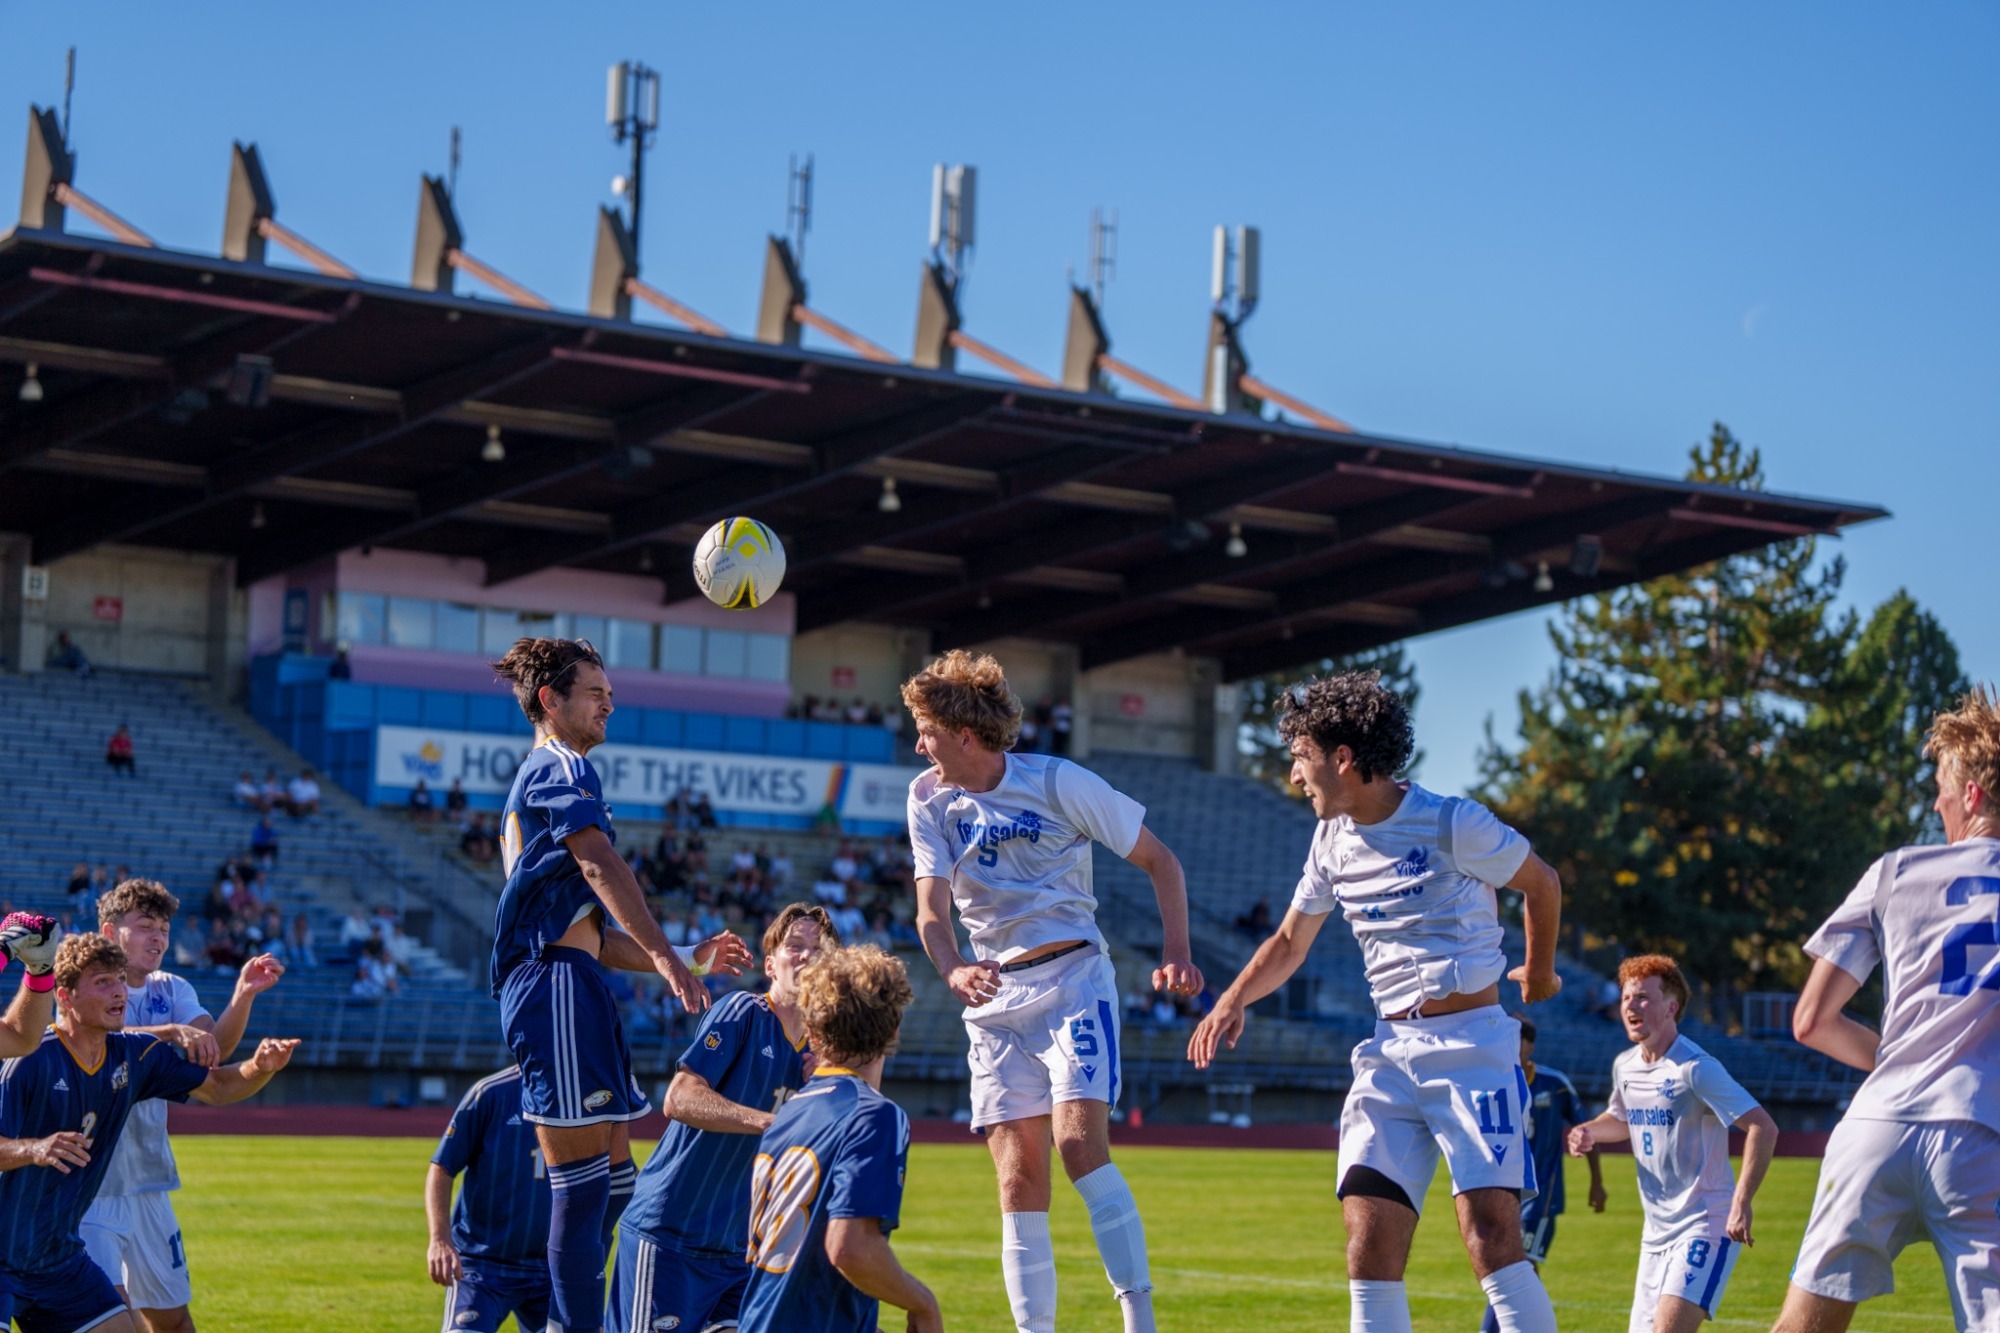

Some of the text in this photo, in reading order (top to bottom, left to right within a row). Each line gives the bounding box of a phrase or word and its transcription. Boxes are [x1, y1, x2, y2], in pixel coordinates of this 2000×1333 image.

[638, 757, 701, 796] THE
[712, 761, 807, 804] VIKES
[1070, 1018, 1098, 1057] 5
[1476, 1088, 1514, 1135] 11
[1642, 1132, 1654, 1156] 8
[168, 1228, 186, 1270] 1
[1687, 1239, 1710, 1269] 8
